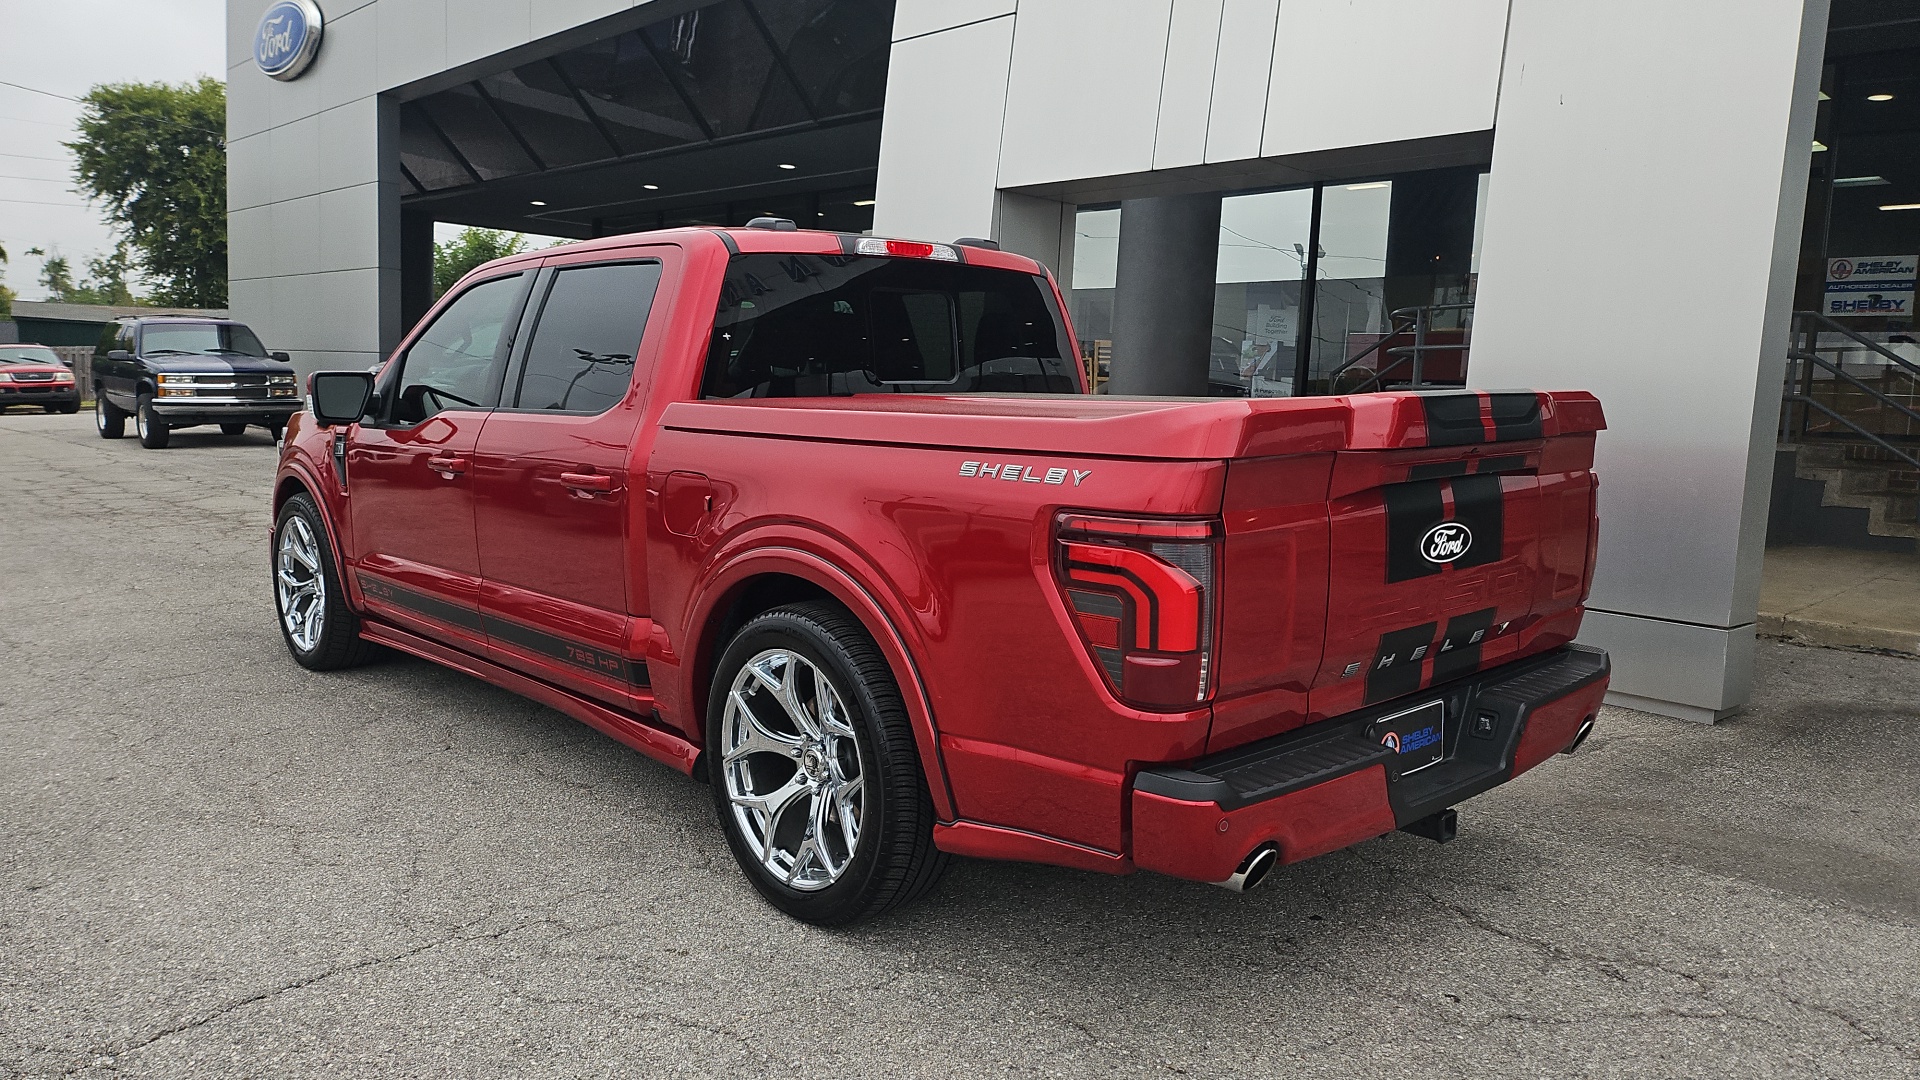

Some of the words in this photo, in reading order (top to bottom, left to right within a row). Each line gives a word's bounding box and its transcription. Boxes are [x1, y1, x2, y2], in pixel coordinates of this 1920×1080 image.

[260, 14, 293, 62] Ford
[1857, 261, 1902, 269] SHELBY
[1831, 300, 1905, 310] SHELBY
[958, 460, 1092, 487] SHELBY
[1430, 528, 1465, 558] Ford
[1341, 621, 1510, 679] SHELBY
[598, 656, 620, 671] HP
[1400, 731, 1442, 755] AMERICAN
[1402, 725, 1434, 745] SHELBY
